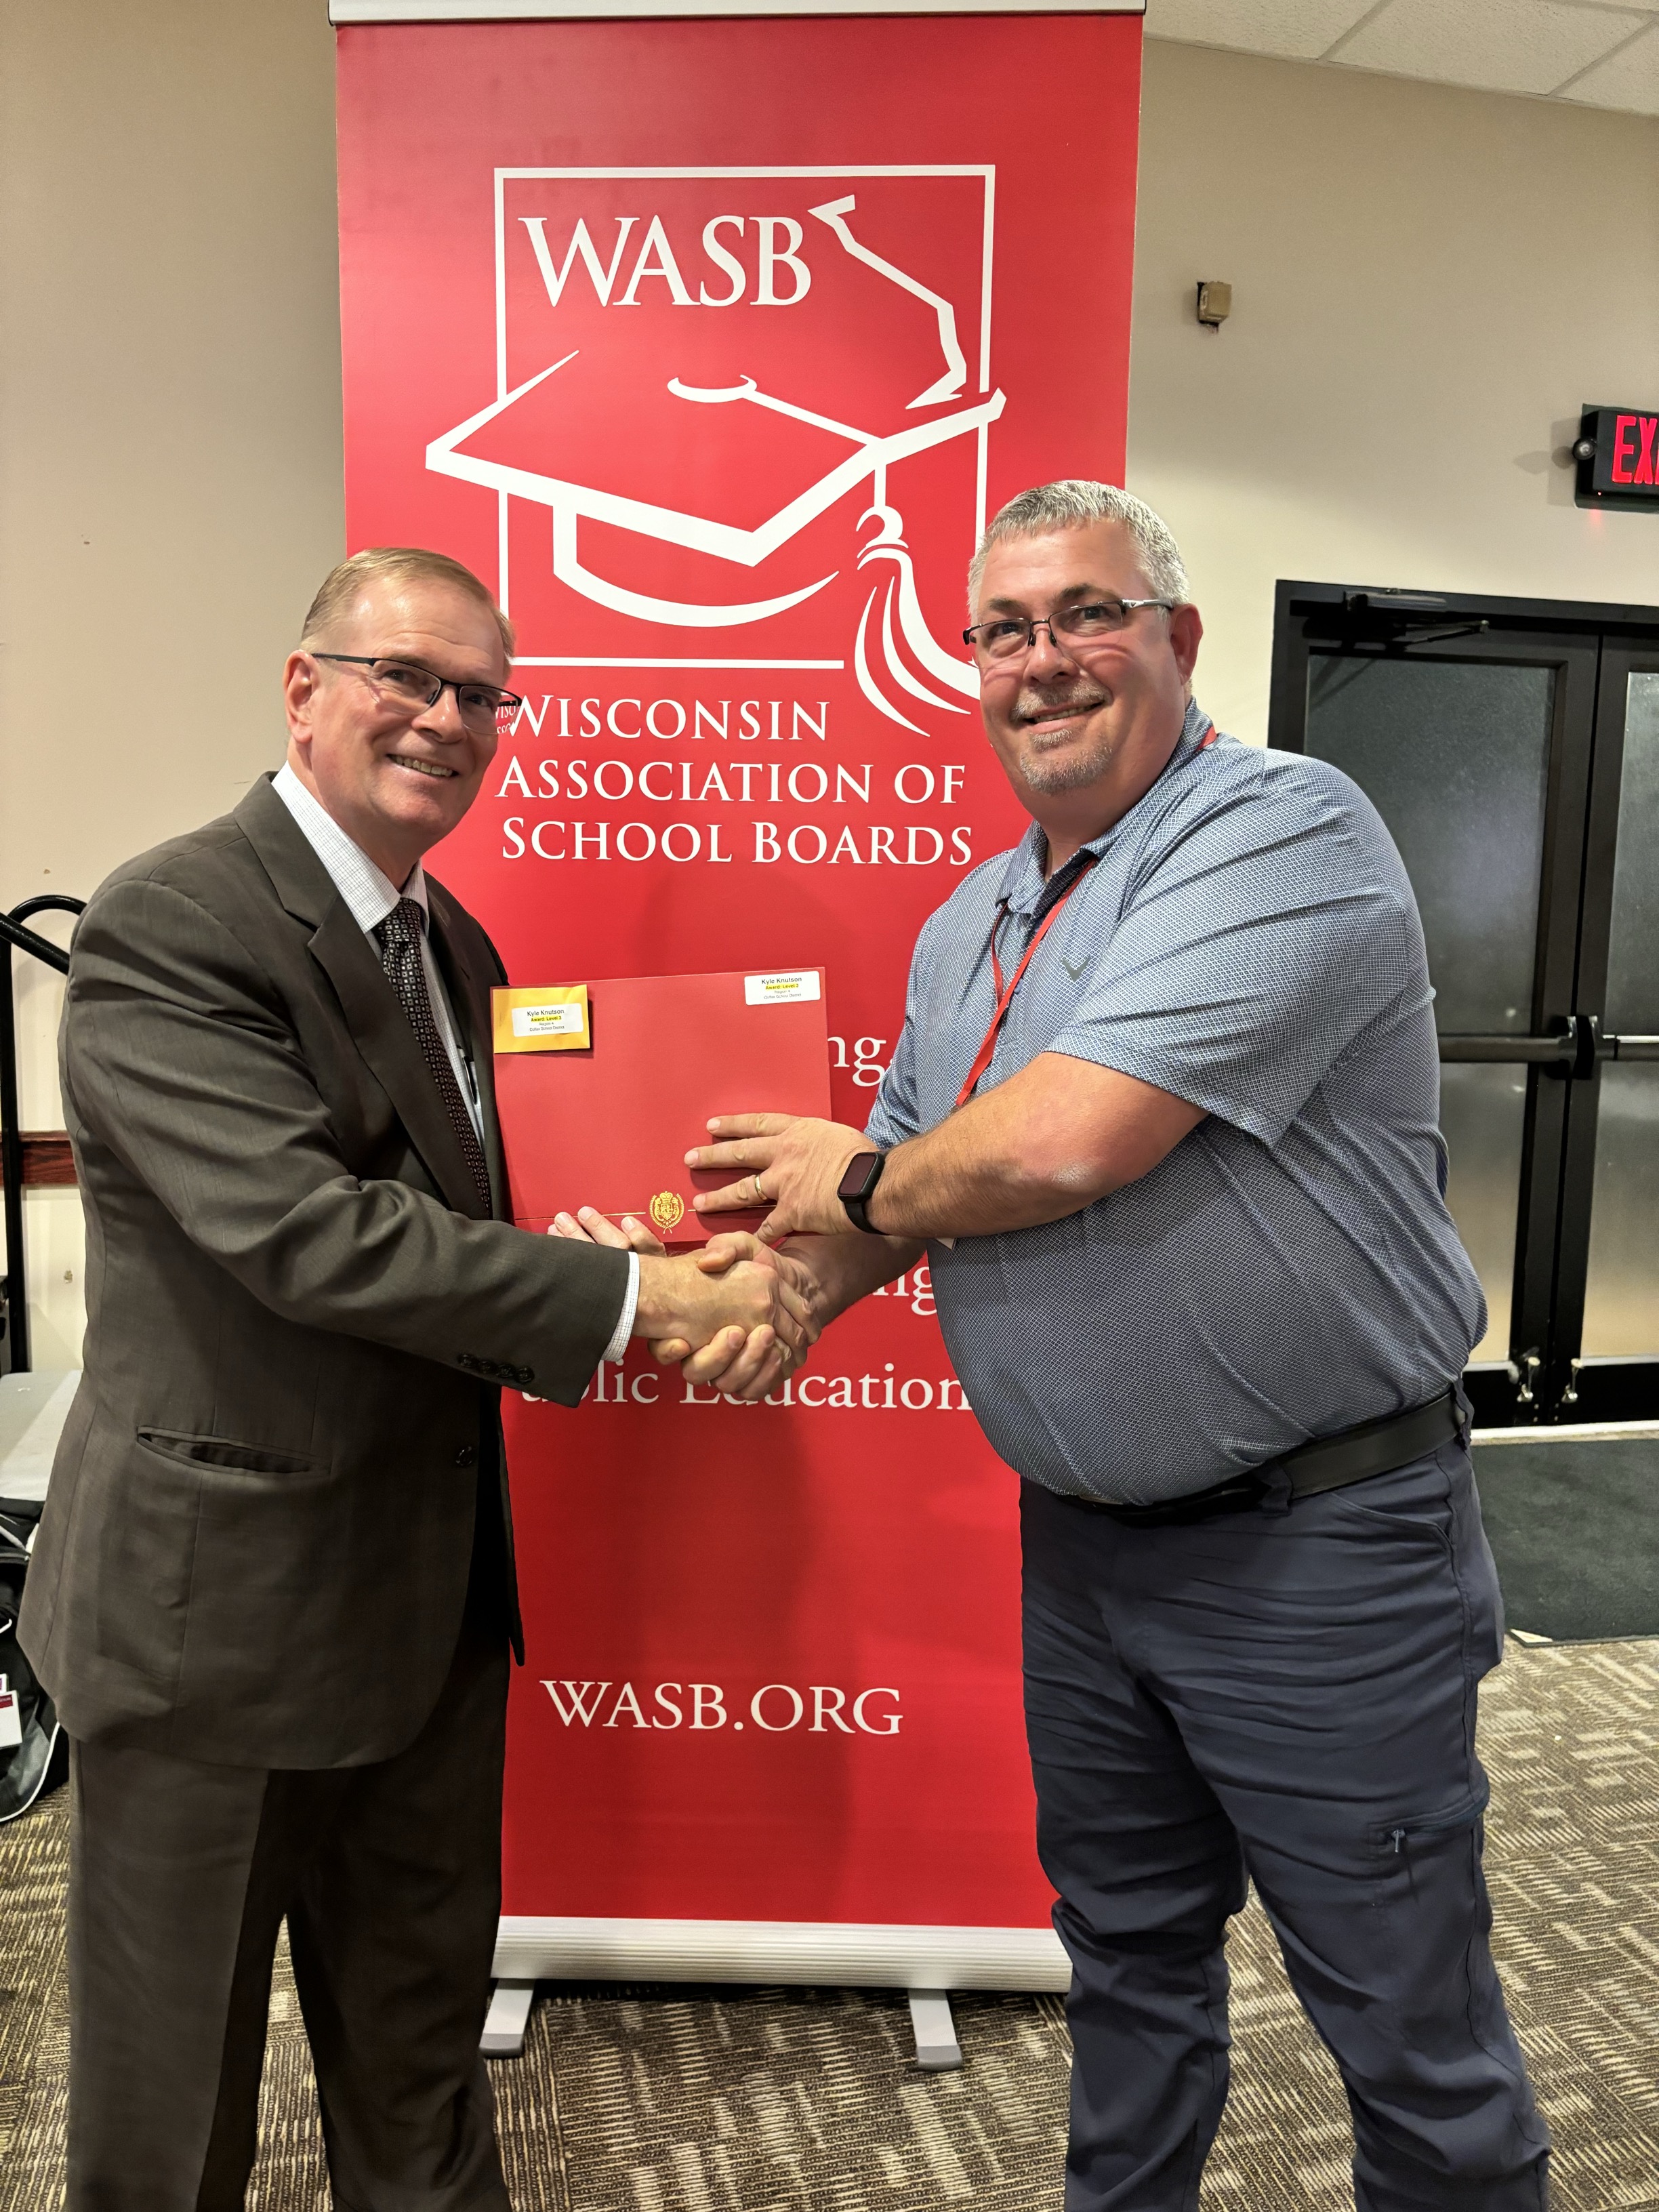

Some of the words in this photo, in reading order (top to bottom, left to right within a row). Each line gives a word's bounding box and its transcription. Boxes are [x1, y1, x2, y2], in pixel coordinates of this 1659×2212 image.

[518, 215, 811, 307] WASB
[510, 694, 830, 741] WISCONSIN
[495, 756, 874, 803] ASSOCIATION
[895, 764, 965, 804] OF
[502, 817, 732, 862] SCHOOL
[752, 821, 972, 865] BOARDS
[539, 1680, 903, 1735] WASB.ORG
